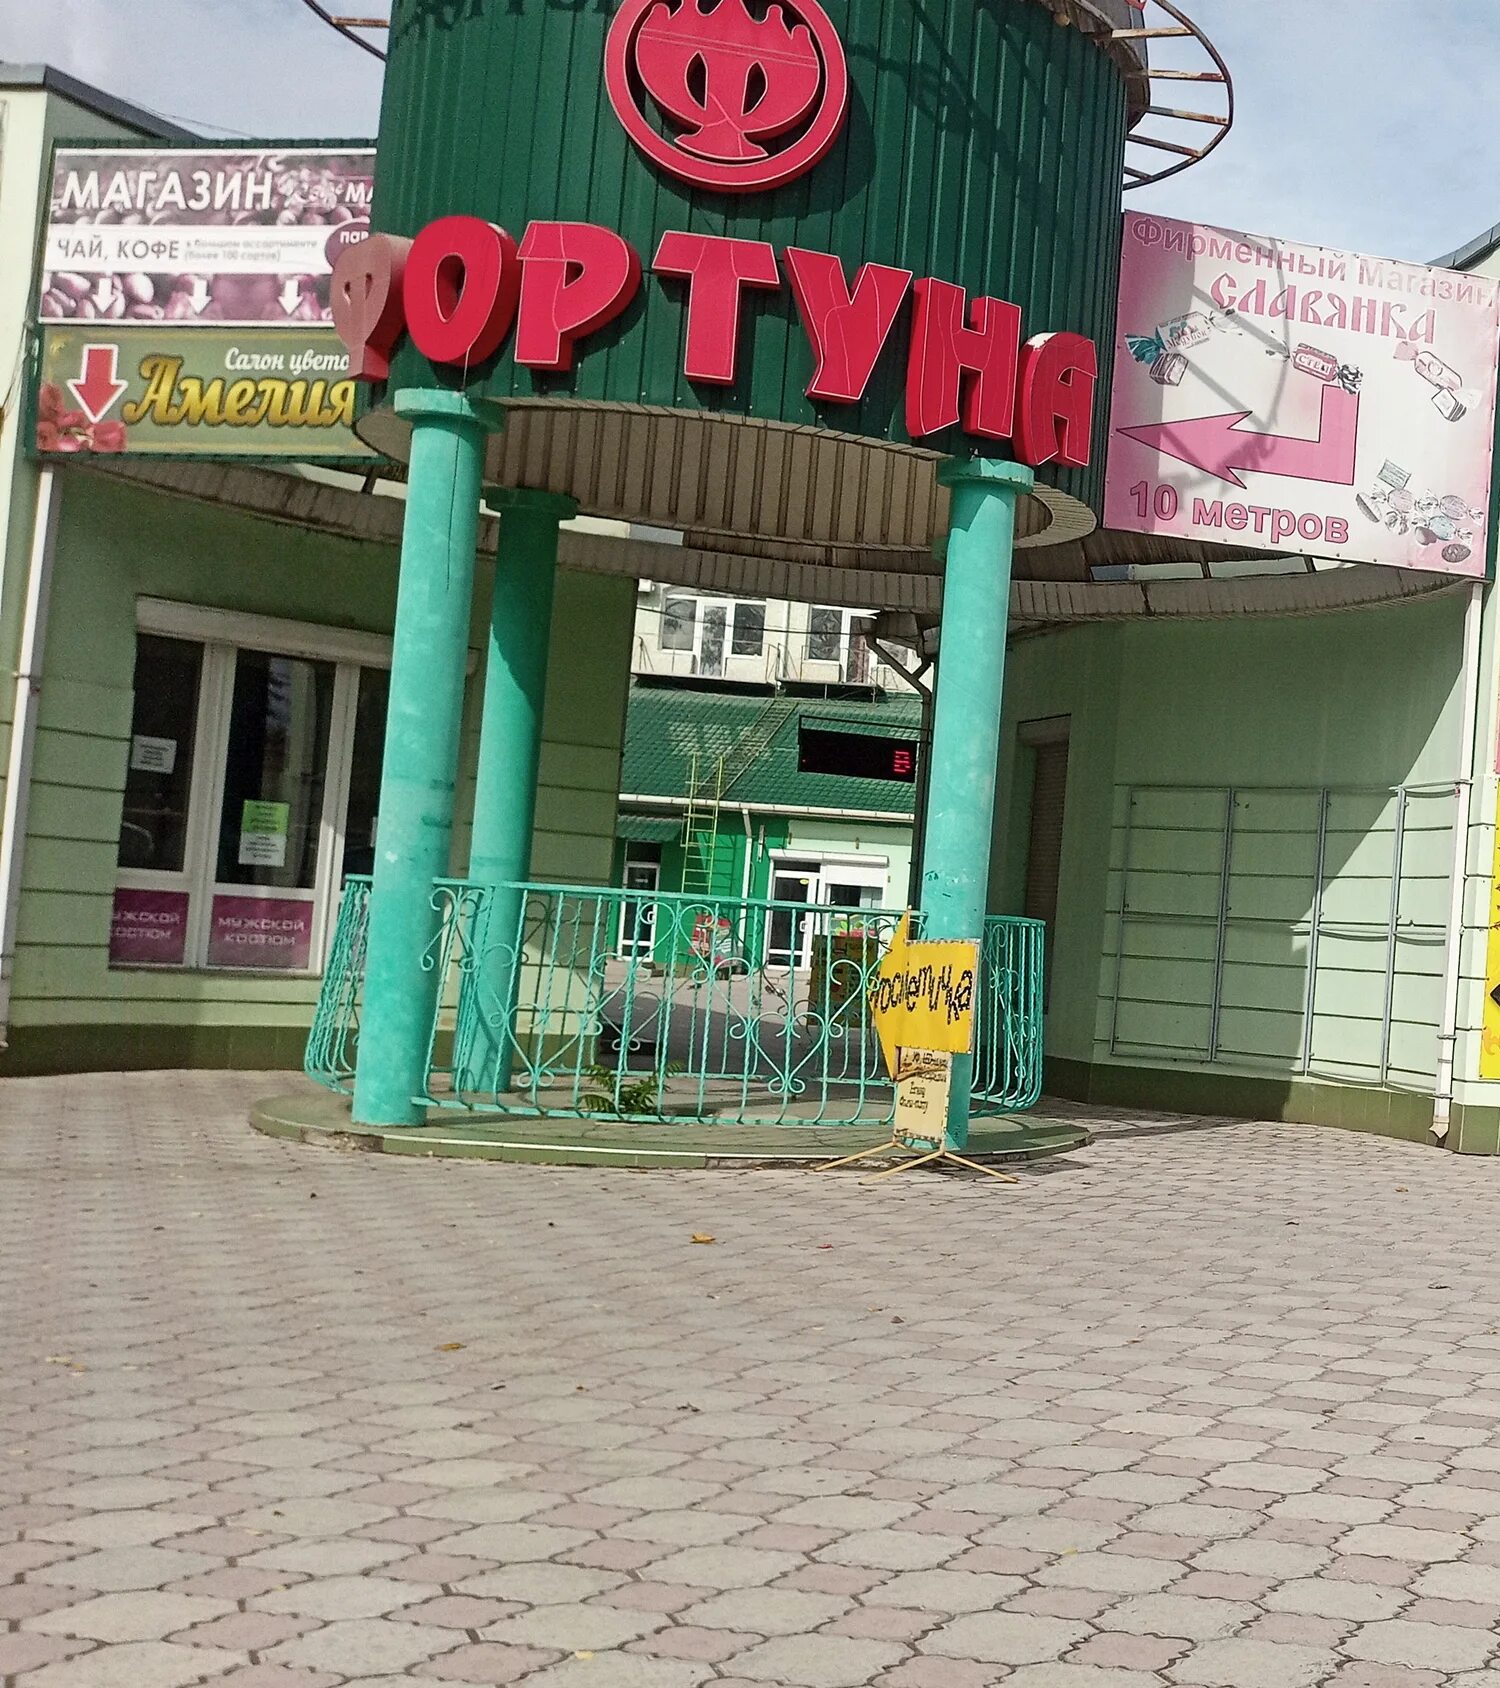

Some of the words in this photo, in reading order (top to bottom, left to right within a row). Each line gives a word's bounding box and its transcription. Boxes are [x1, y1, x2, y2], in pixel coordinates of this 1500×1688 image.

[61, 170, 274, 211] МАГАЗИН
[57, 234, 109, 261] ЧАЙ,
[117, 238, 180, 261] КОФЕ
[1132, 216, 1347, 283] Фирменный
[1358, 257, 1495, 309] Магазин
[225, 347, 284, 371] Салон
[330, 214, 1099, 468] ФОРТУНА
[121, 354, 357, 428] Амелия
[1128, 480, 1179, 521] 10
[1192, 496, 1350, 545] метров
